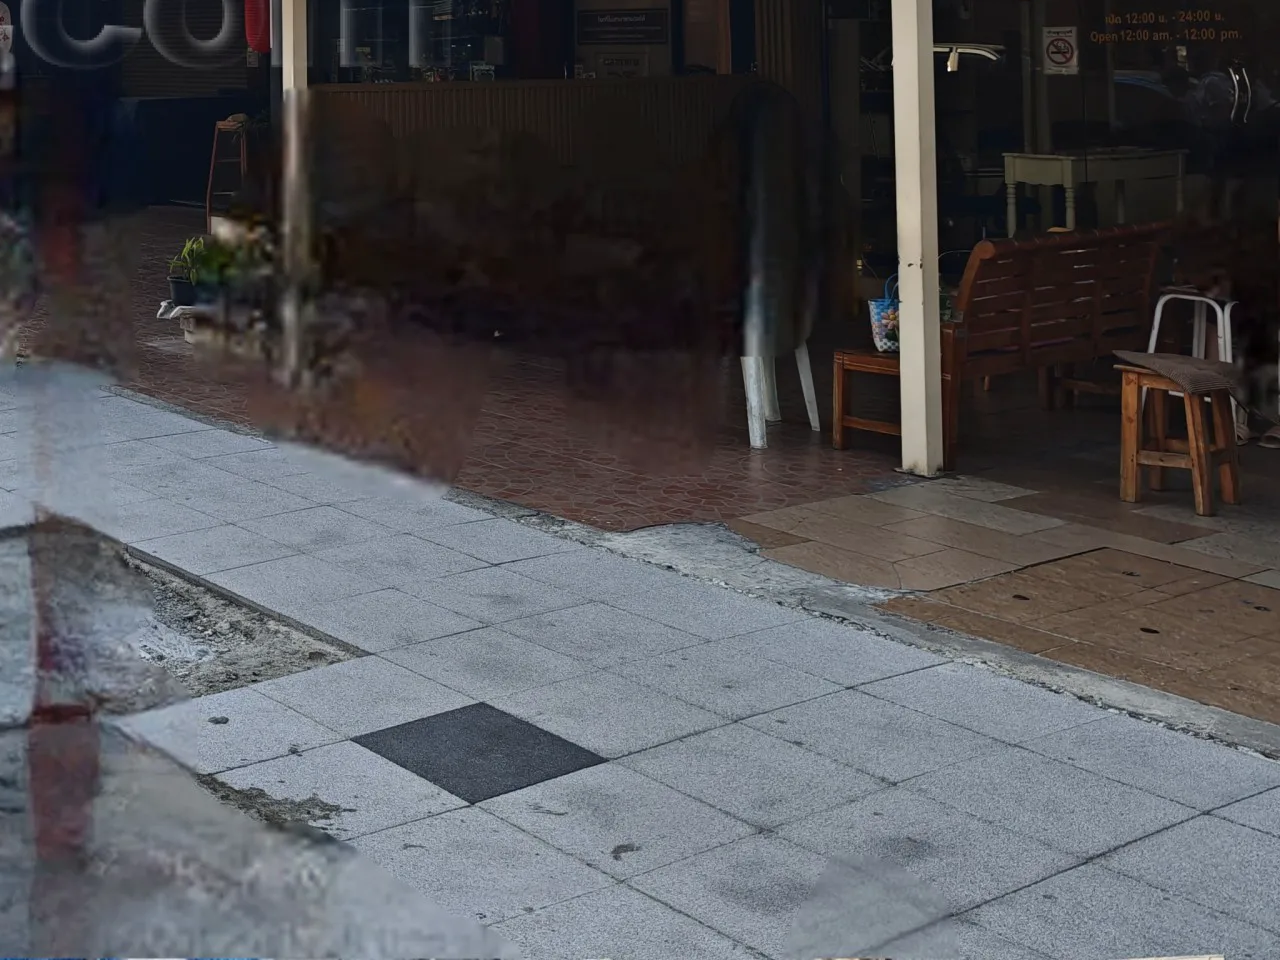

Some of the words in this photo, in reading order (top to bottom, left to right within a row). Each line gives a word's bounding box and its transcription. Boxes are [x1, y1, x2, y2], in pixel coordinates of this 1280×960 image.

[1125, 12, 1155, 25] 12:00
[1178, 10, 1211, 23] 24:00
[1090, 30, 1118, 44] Open
[1119, 29, 1149, 42] 12:00
[1184, 28, 1216, 41] 12:00
